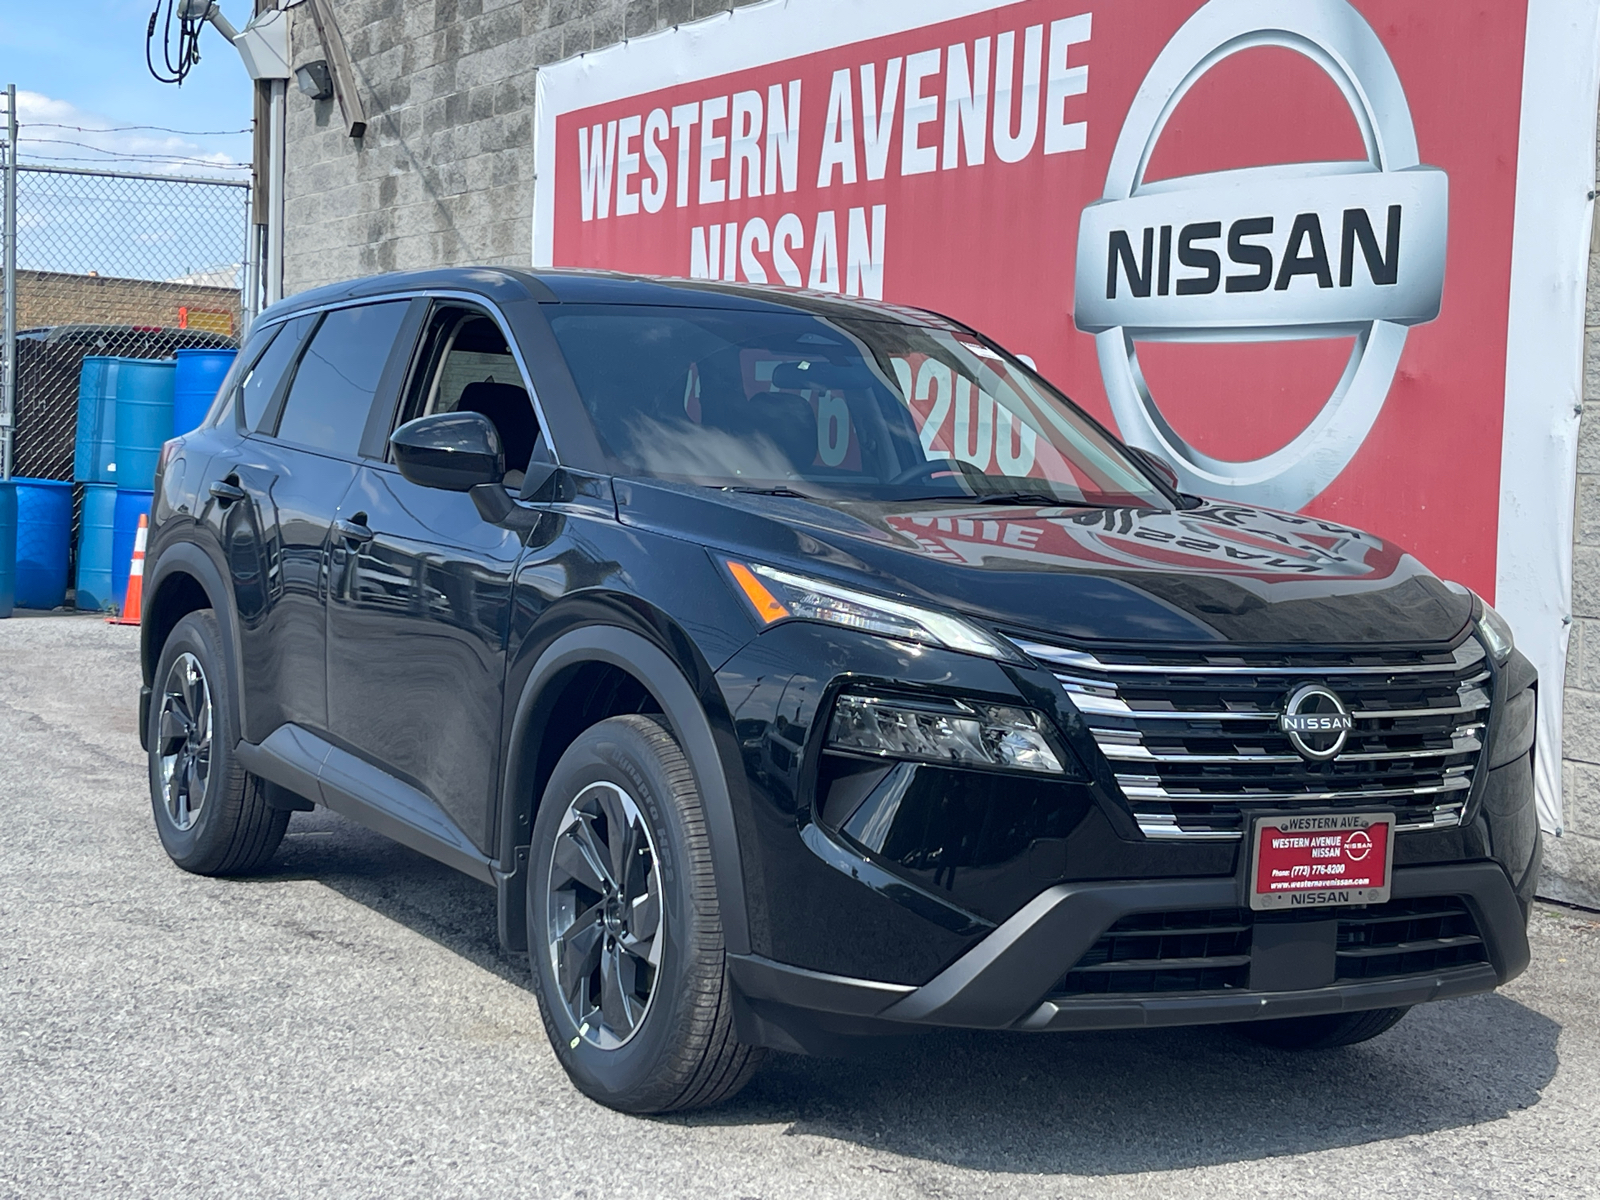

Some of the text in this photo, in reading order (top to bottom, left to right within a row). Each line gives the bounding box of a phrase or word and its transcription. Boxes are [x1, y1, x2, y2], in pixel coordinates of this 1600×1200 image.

[578, 12, 1093, 222] WESTERN AVENUE
[690, 204, 887, 301] NISSAN
[1105, 204, 1402, 300] NISSAN
[1284, 717, 1352, 730] NISSAN
[1289, 816, 1360, 830] WESTERN AVE
[1272, 836, 1342, 849] WESTERN AVENUE
[1311, 847, 1341, 859] NISSAN
[1271, 864, 1346, 878] Phone: (773) 776-8200
[1270, 878, 1370, 889] www.westernavenissan.com
[1291, 891, 1349, 905] NISSAN
